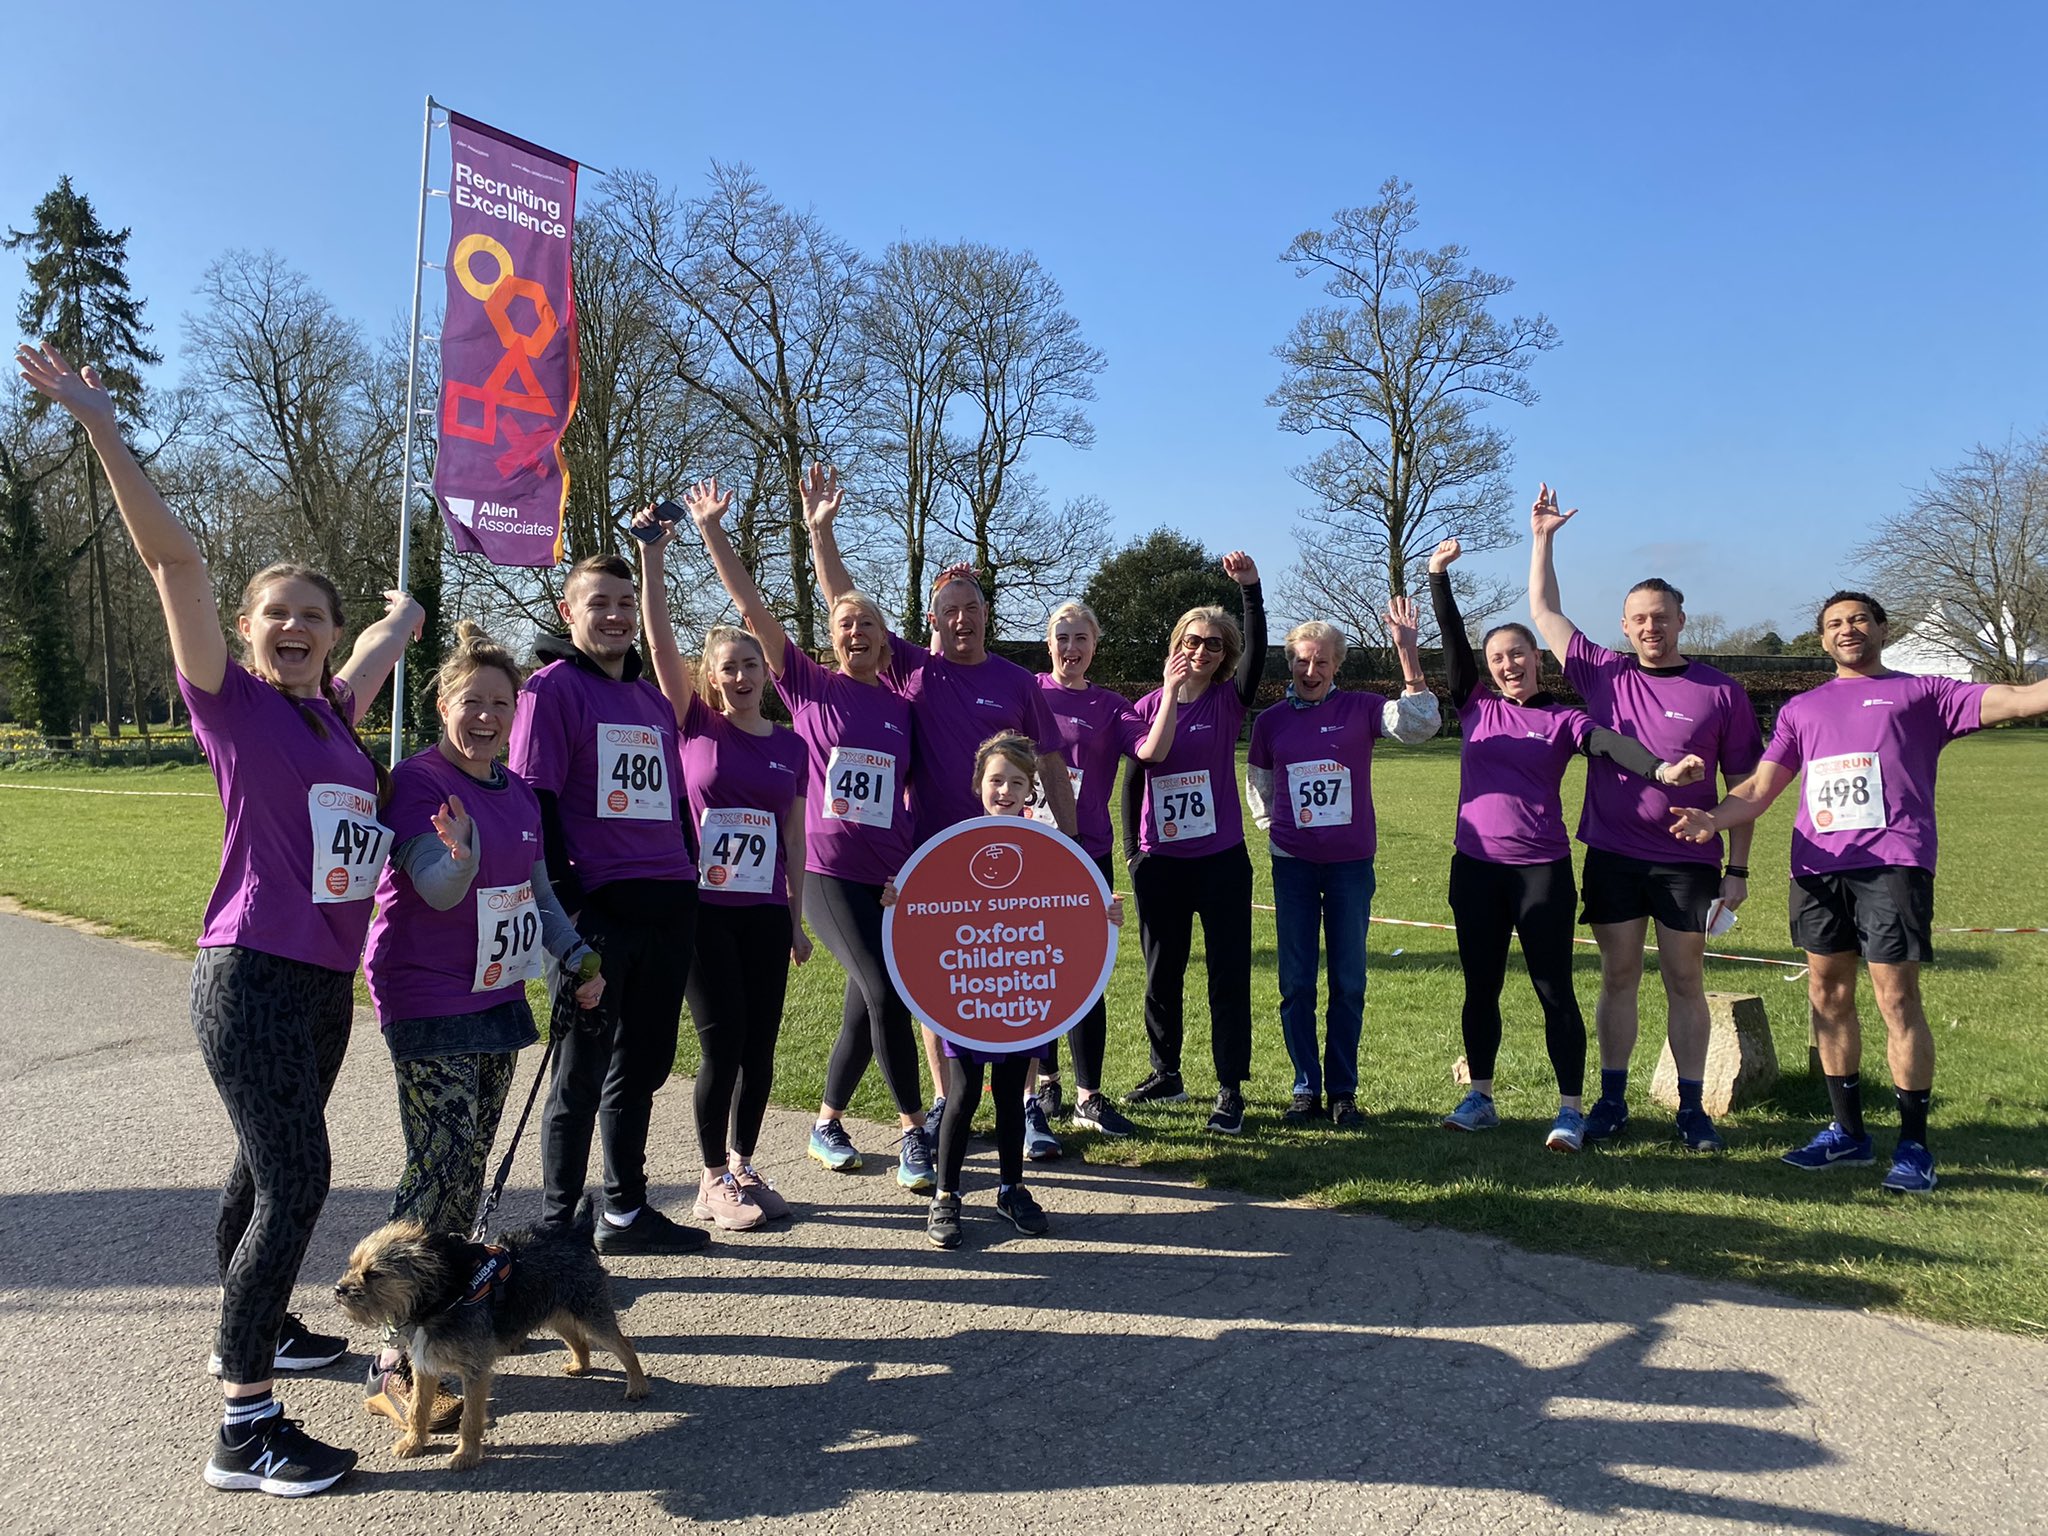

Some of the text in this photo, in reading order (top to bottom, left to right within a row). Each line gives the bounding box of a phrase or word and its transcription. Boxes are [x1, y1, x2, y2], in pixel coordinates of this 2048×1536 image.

[455, 162, 561, 220] Recruiting
[455, 185, 567, 239] Excellence
[479, 502, 518, 518] Allen
[478, 517, 554, 536] Associates
[611, 753, 662, 792] 480
[836, 770, 882, 803] 481
[1163, 791, 1205, 821] 578
[1299, 779, 1342, 808] 587
[1818, 776, 1870, 809] 498
[331, 819, 383, 865] 497
[712, 833, 766, 867] 479
[907, 894, 1090, 915] PROUDLY SUPPORTING
[490, 912, 537, 962] 510
[955, 920, 1045, 945] Oxford
[939, 944, 1065, 970] Children's
[950, 969, 1057, 998] Hospital
[957, 996, 1051, 1021] Charity
